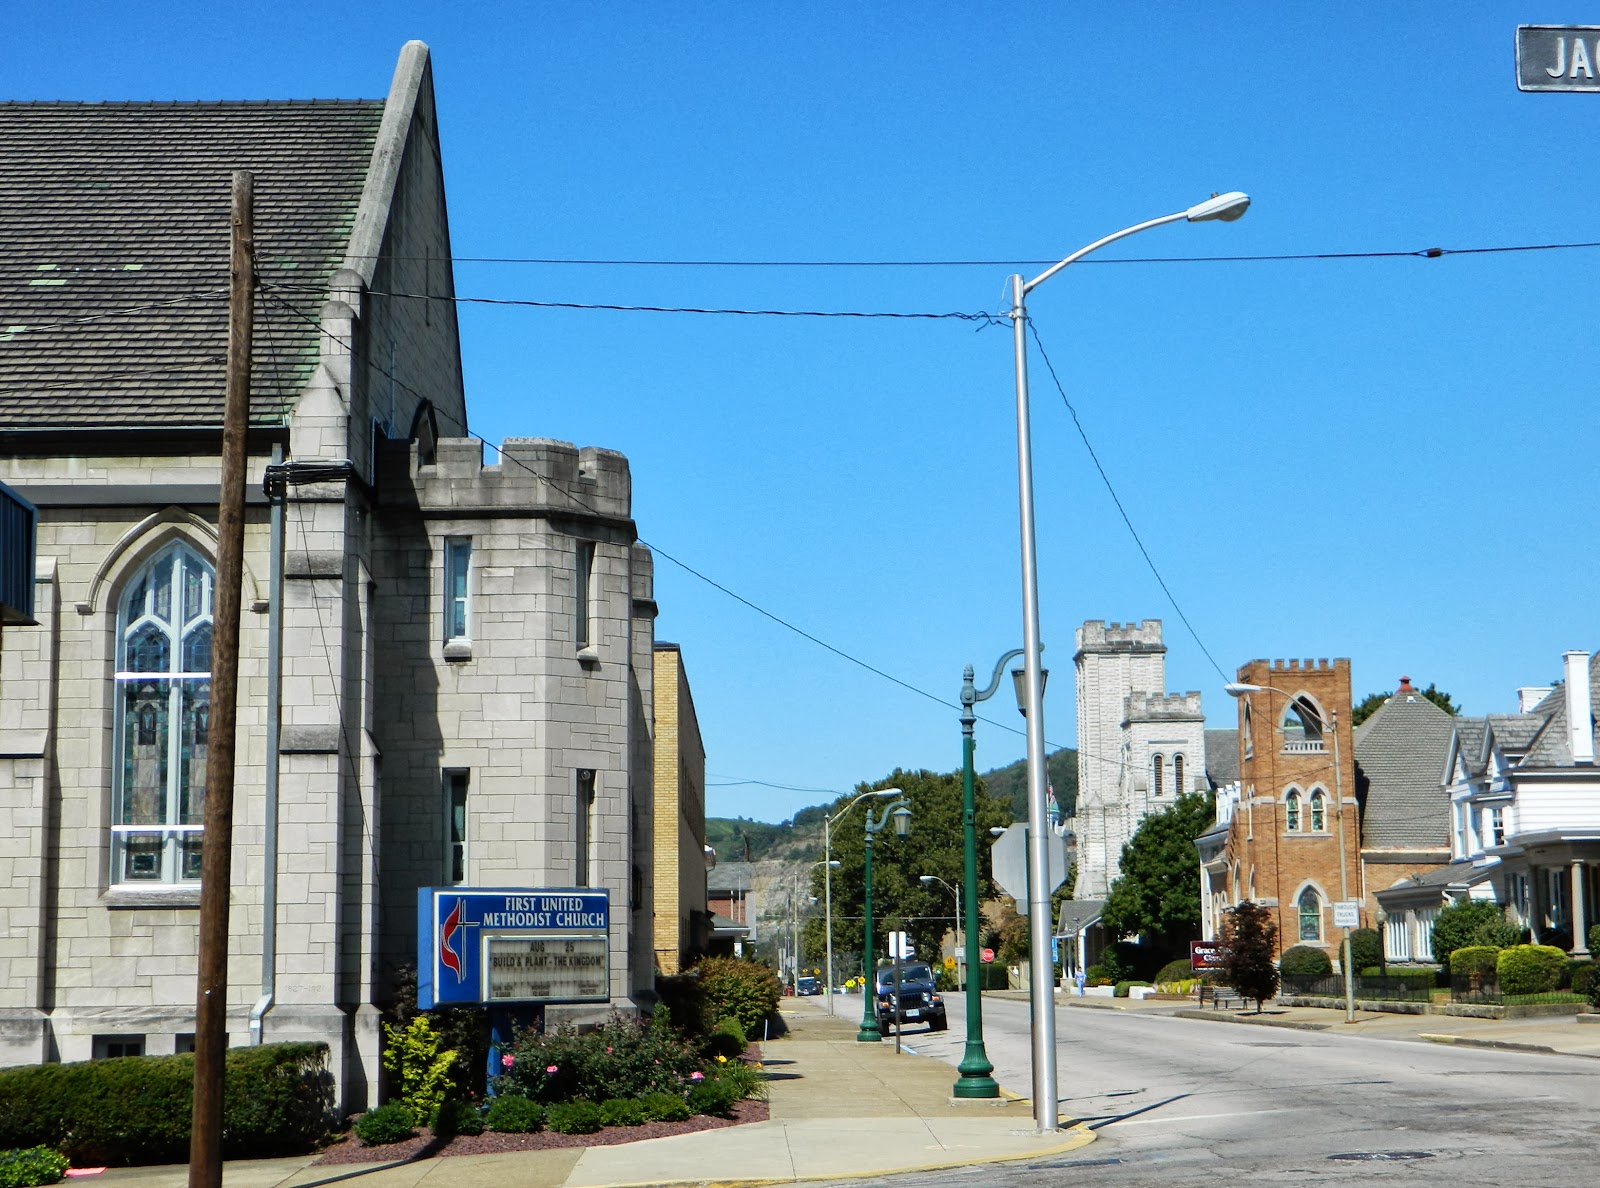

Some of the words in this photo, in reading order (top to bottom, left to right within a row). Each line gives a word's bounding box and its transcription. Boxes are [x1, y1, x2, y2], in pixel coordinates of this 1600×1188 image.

[1545, 37, 1600, 78] JA
[505, 898, 536, 911] FIRST
[541, 897, 583, 911] UNITED
[483, 913, 551, 926] METHODIST
[556, 912, 604, 926] CHURCH
[530, 942, 545, 952] AUG
[565, 942, 575, 952] 25
[1195, 946, 1216, 955] Grace
[525, 956, 548, 967] PLANT
[554, 955, 567, 966] THE
